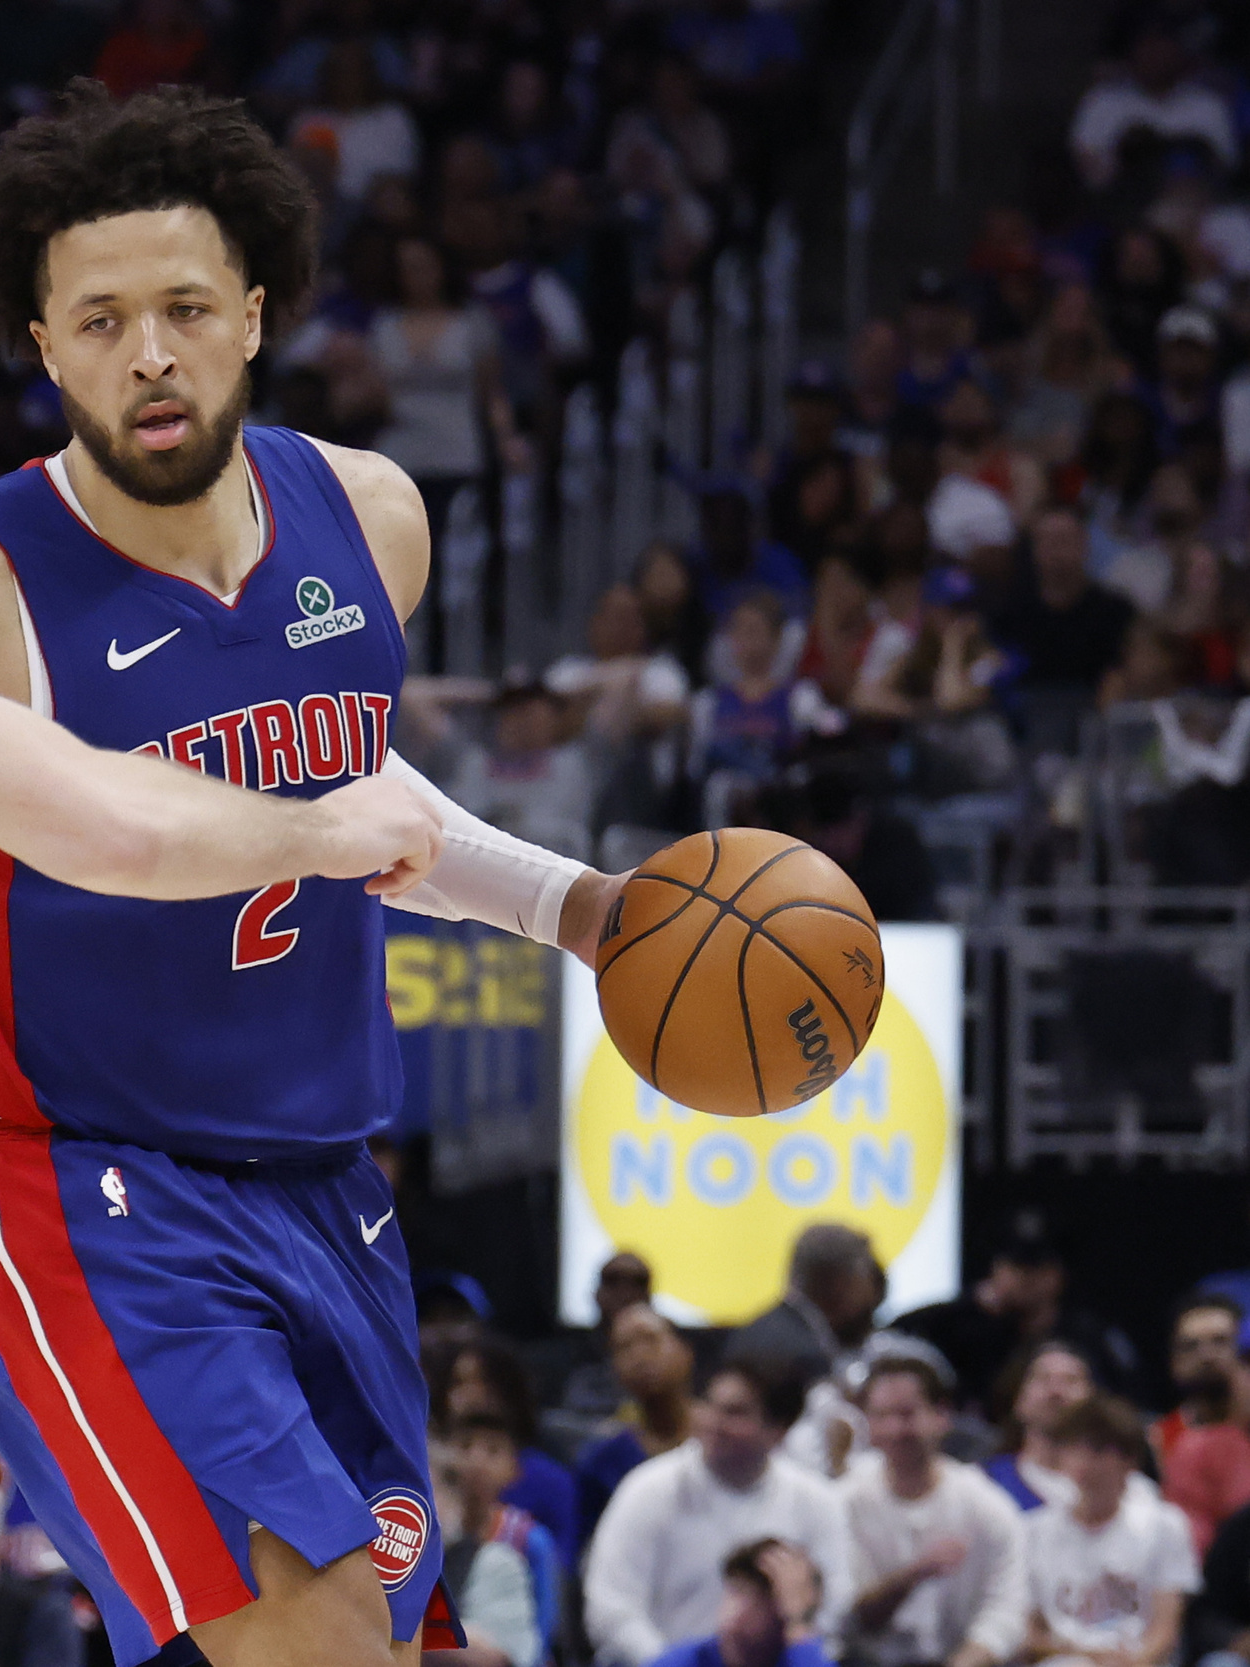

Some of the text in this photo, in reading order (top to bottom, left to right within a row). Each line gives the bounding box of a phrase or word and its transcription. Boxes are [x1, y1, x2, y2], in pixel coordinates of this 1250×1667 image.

[288, 608, 362, 644] StockX
[126, 691, 392, 791] ETROIT
[231, 877, 300, 971] 2
[609, 1130, 914, 1208] NOON
[371, 1535, 414, 1563] ISTONS
